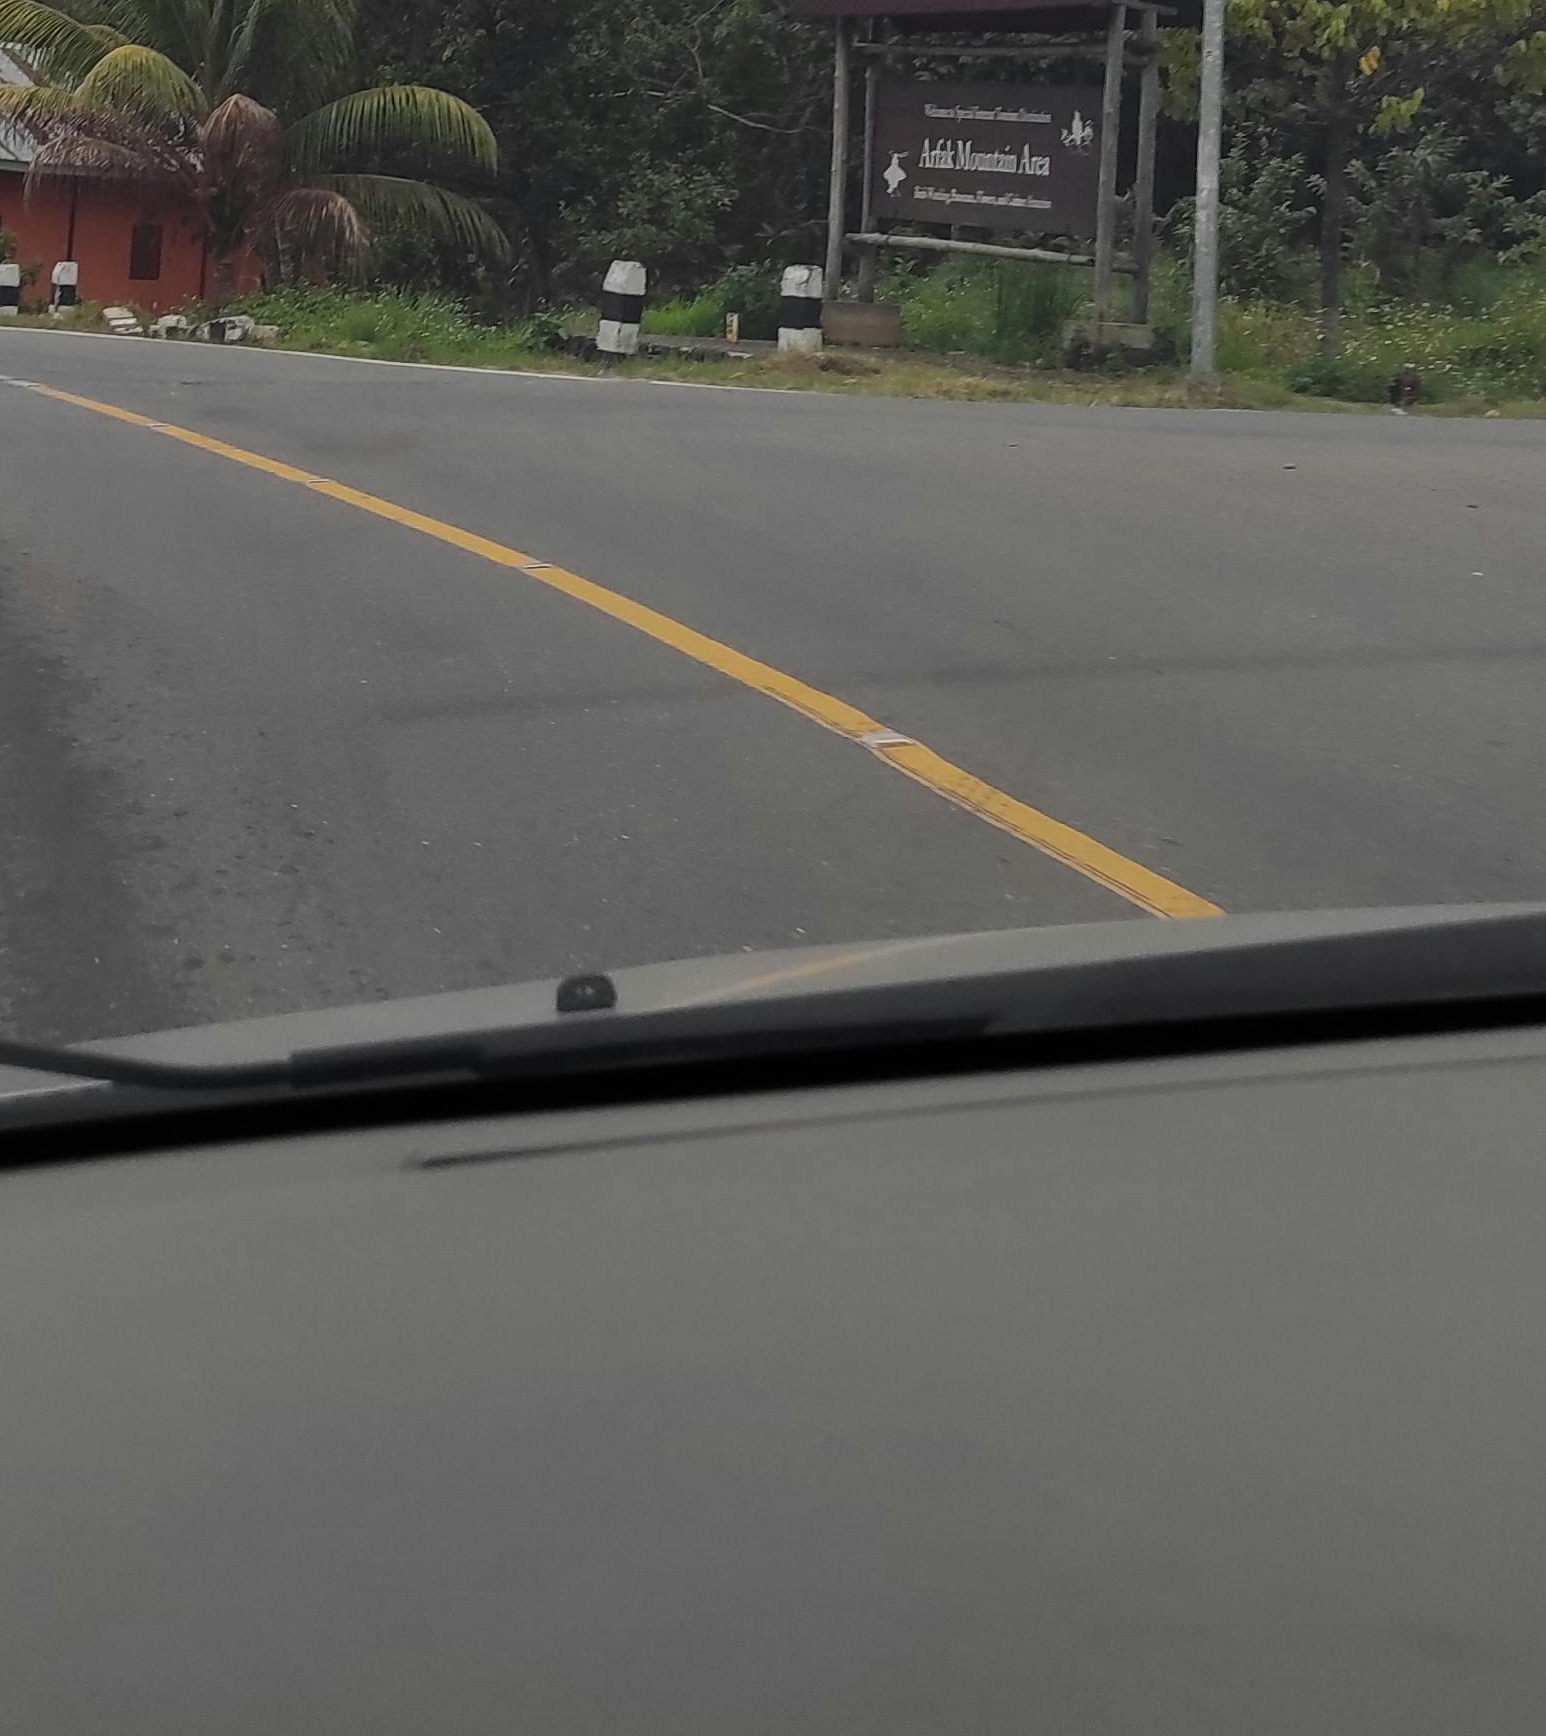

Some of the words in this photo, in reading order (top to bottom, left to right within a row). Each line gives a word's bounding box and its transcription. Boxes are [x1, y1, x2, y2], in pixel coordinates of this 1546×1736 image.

[918, 137, 955, 169] Arfak
[955, 140, 1017, 173] Mountain
[1017, 142, 1051, 176] Area
